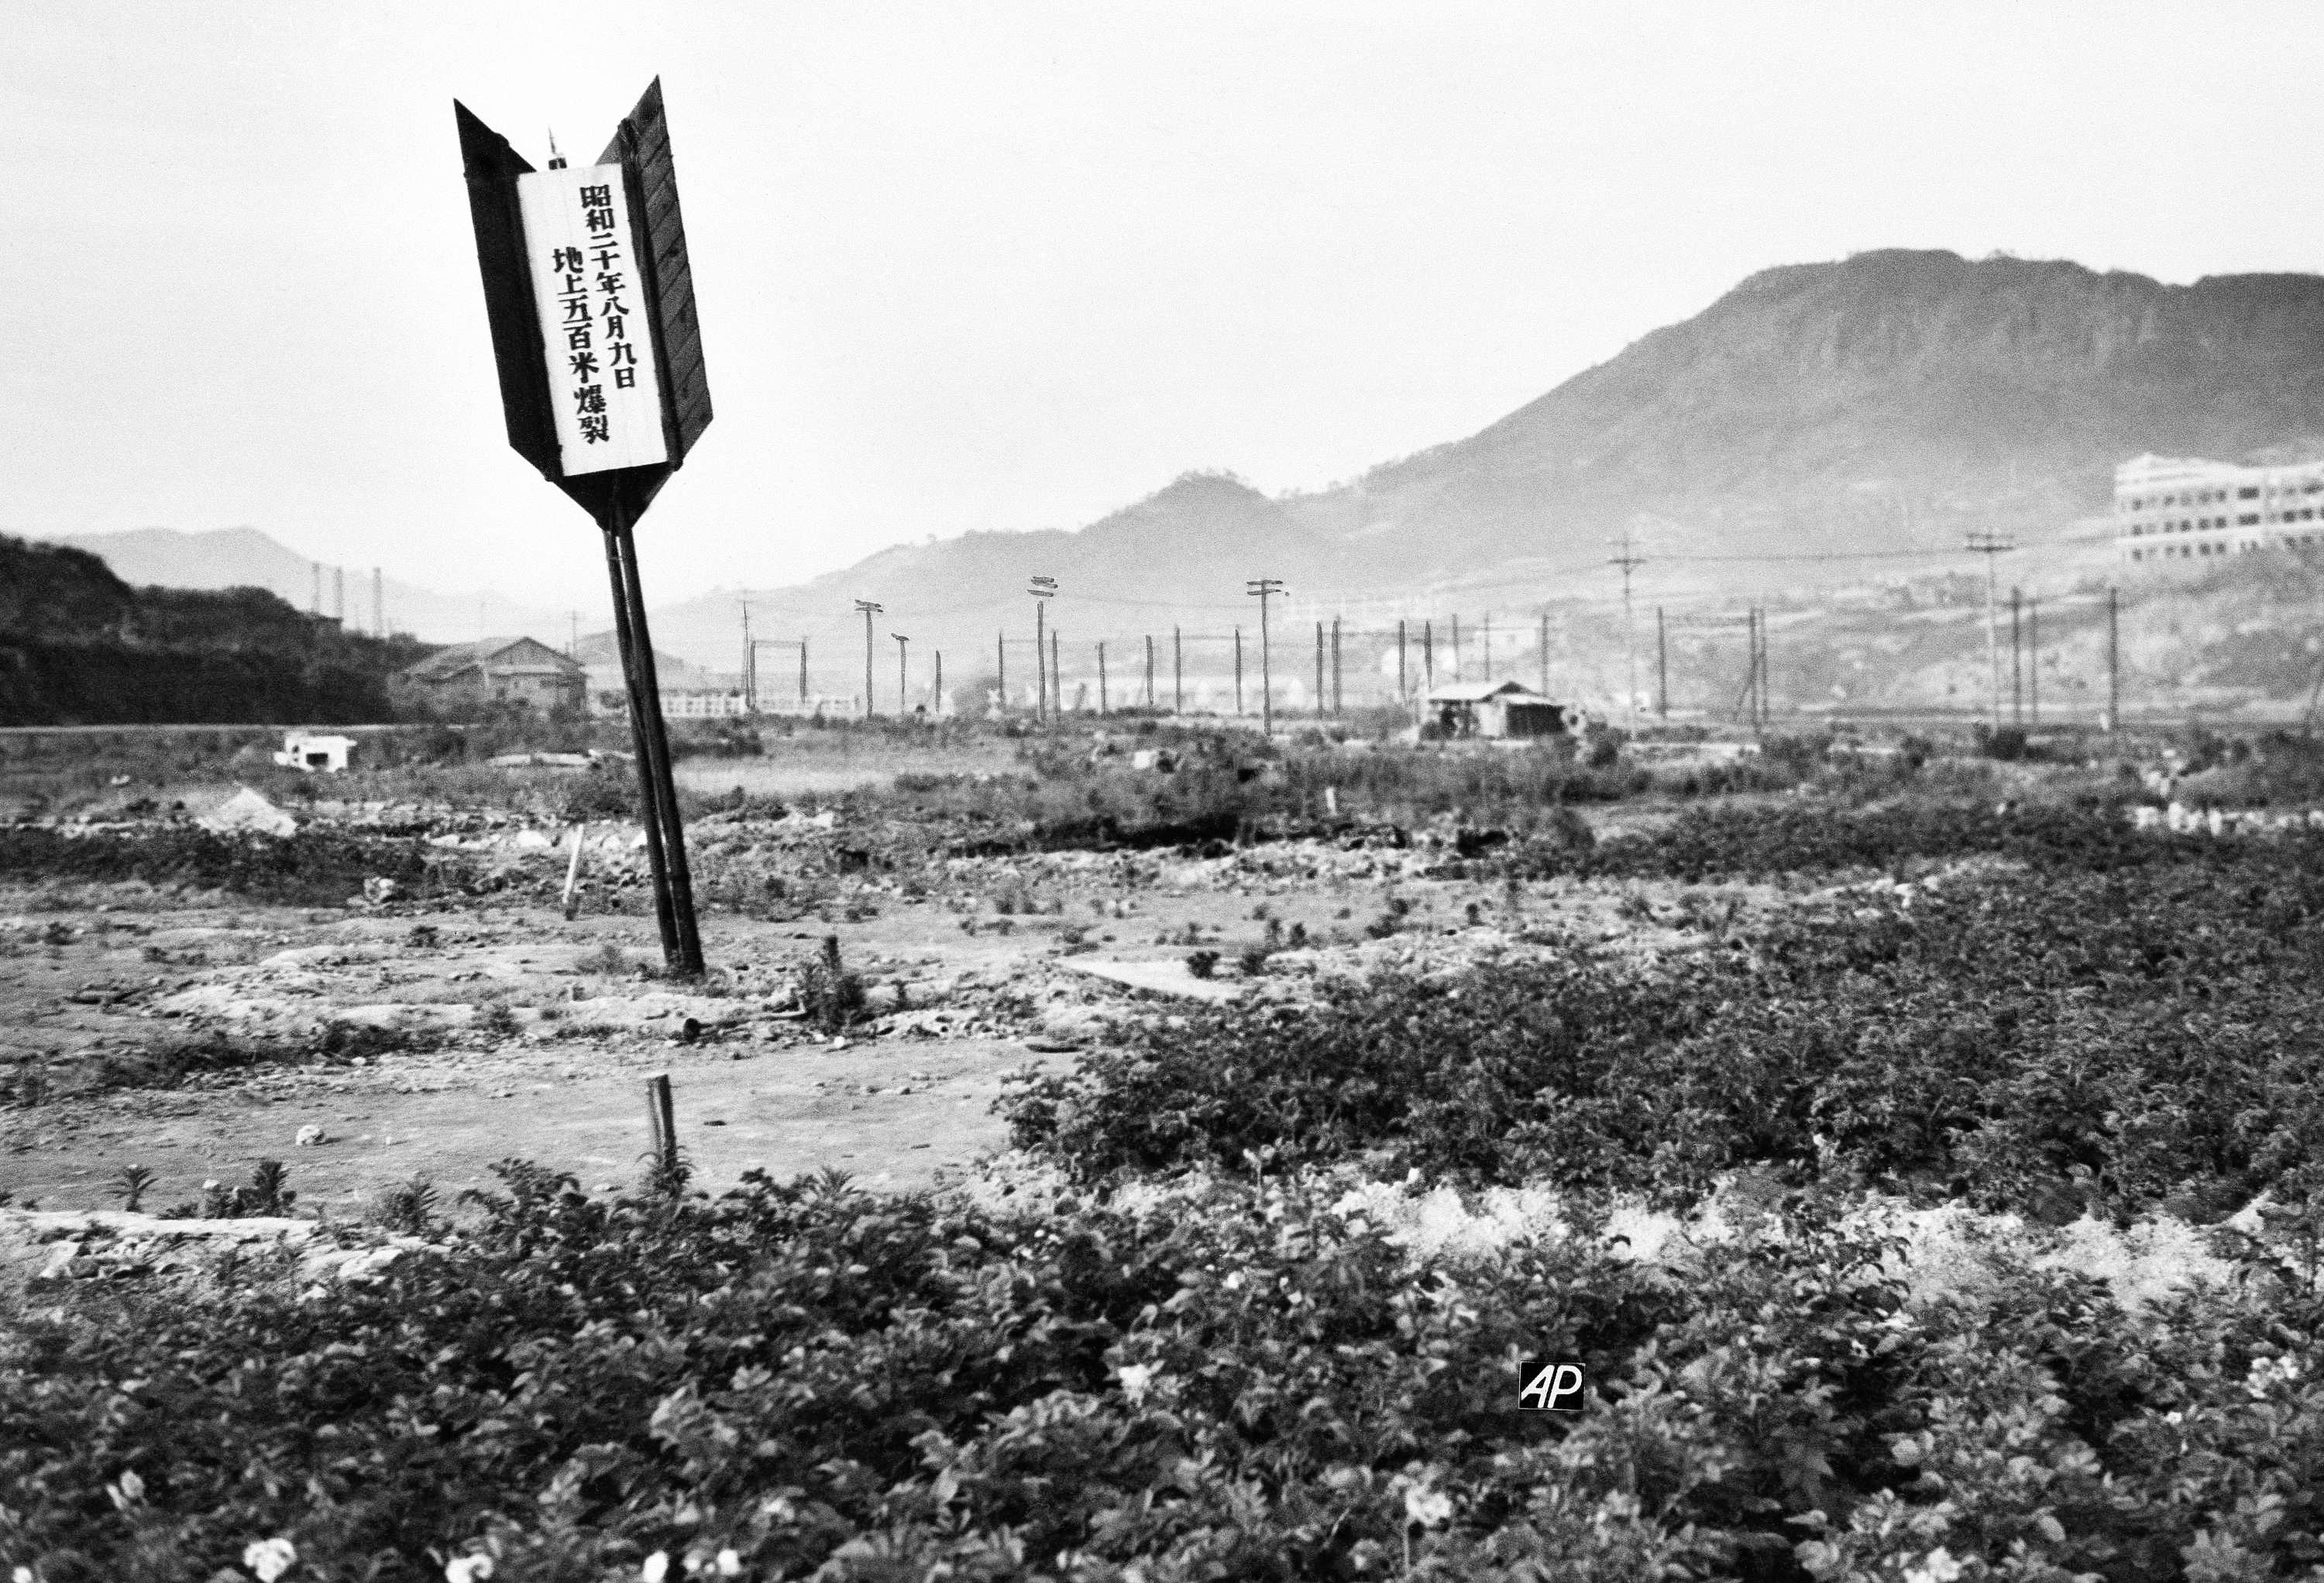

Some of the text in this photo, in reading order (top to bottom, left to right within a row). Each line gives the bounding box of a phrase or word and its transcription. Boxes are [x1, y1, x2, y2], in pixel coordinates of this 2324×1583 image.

[552, 246, 610, 444] 地上五百米爆裂
[579, 184, 637, 389] 昭和二十年八月九日
